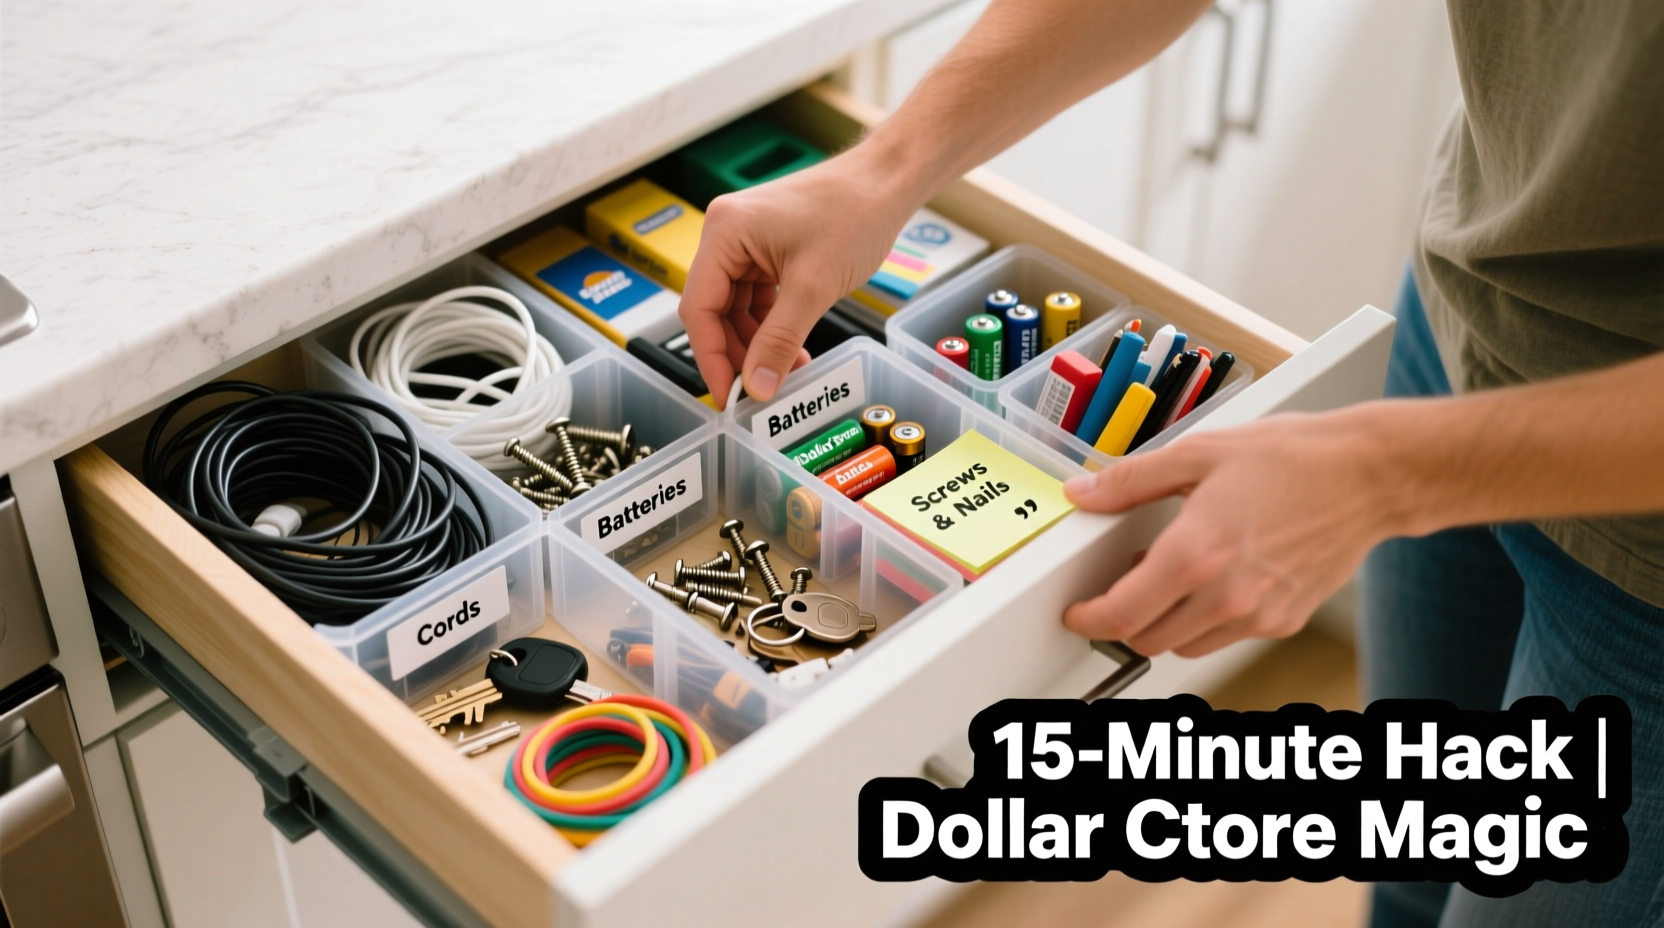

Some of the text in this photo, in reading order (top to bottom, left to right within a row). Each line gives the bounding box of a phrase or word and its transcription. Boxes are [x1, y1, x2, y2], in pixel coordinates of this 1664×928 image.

[768, 382, 850, 437] Batteries
[598, 478, 687, 539] Batteries
[911, 462, 988, 512] Screws
[932, 480, 1010, 531] & Nails
[417, 600, 481, 646] Cords
